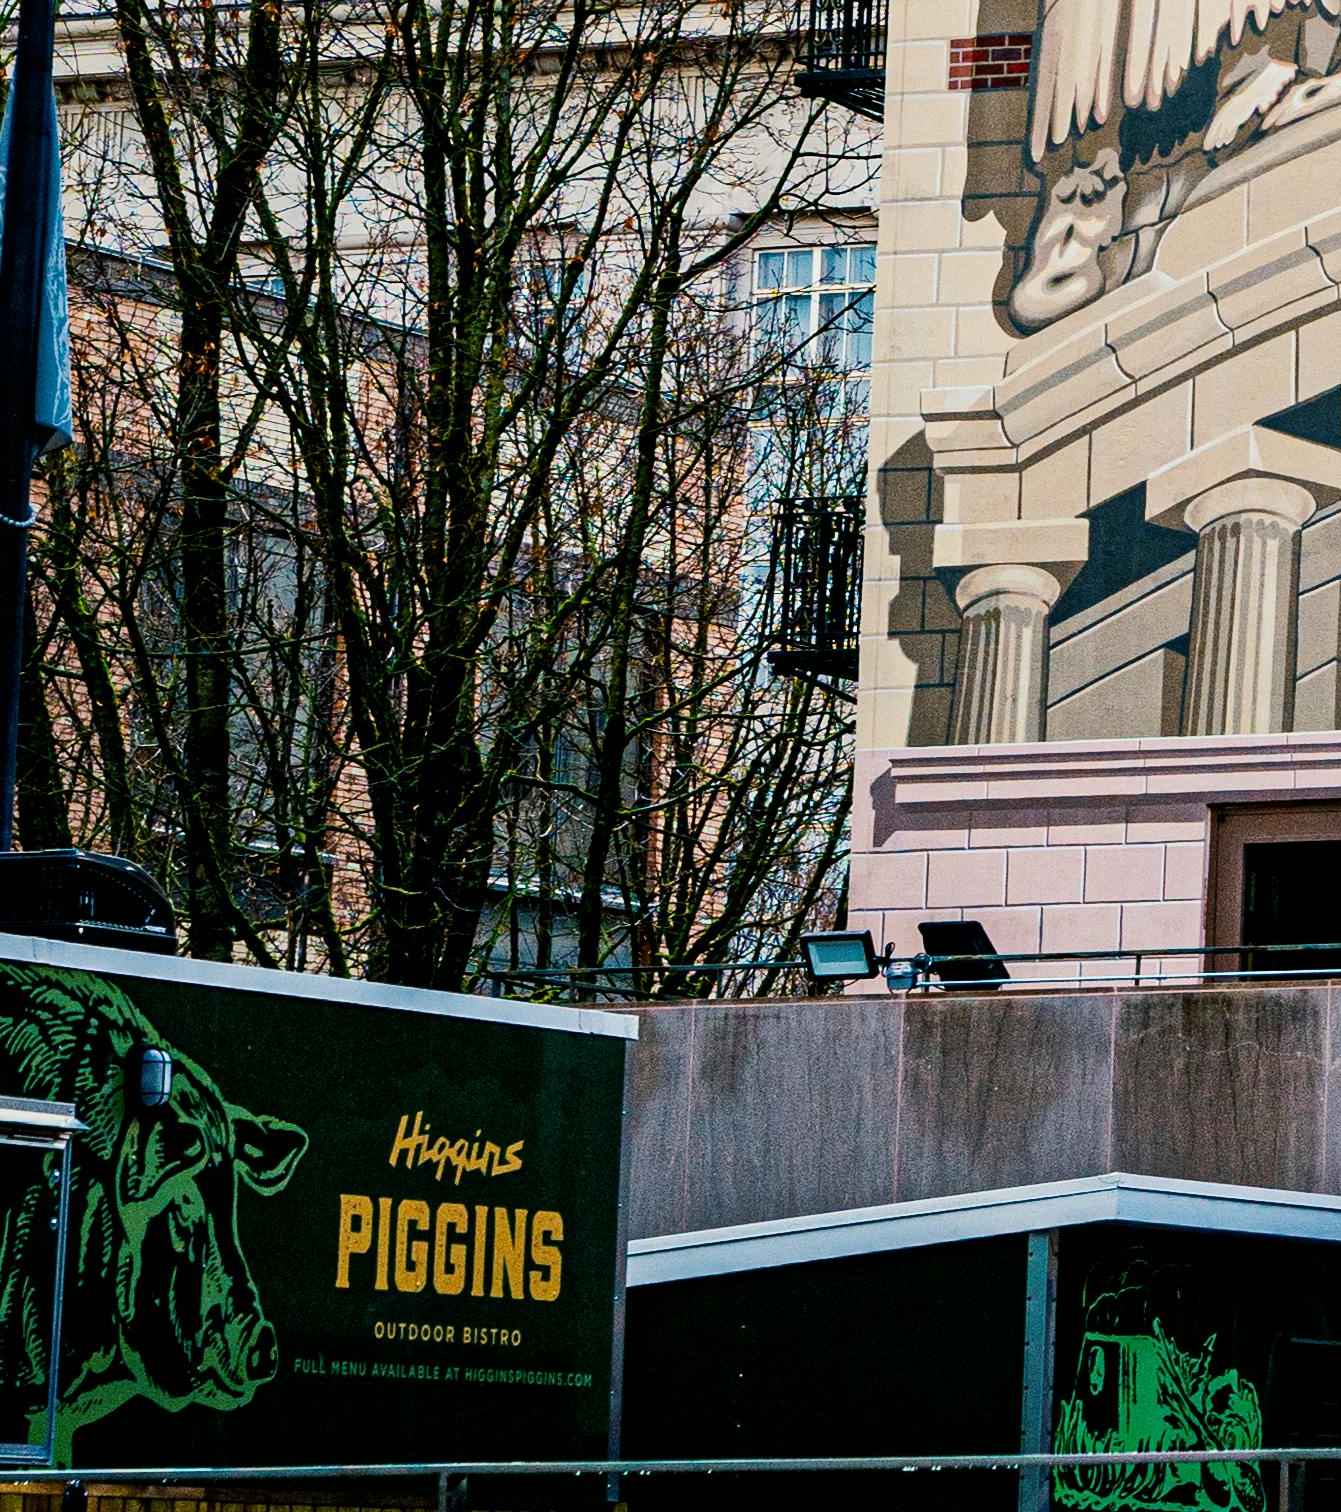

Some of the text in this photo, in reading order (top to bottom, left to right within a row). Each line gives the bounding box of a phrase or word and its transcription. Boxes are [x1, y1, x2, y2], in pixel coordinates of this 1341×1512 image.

[389, 1110, 524, 1186] Higgins
[335, 1193, 564, 1301] PIGGINS
[374, 1321, 522, 1347] OUTDOOR BISTRO
[294, 1358, 592, 1388] FULL MENU AVAILABLE AT HIGGINSPIGGINS.COM
